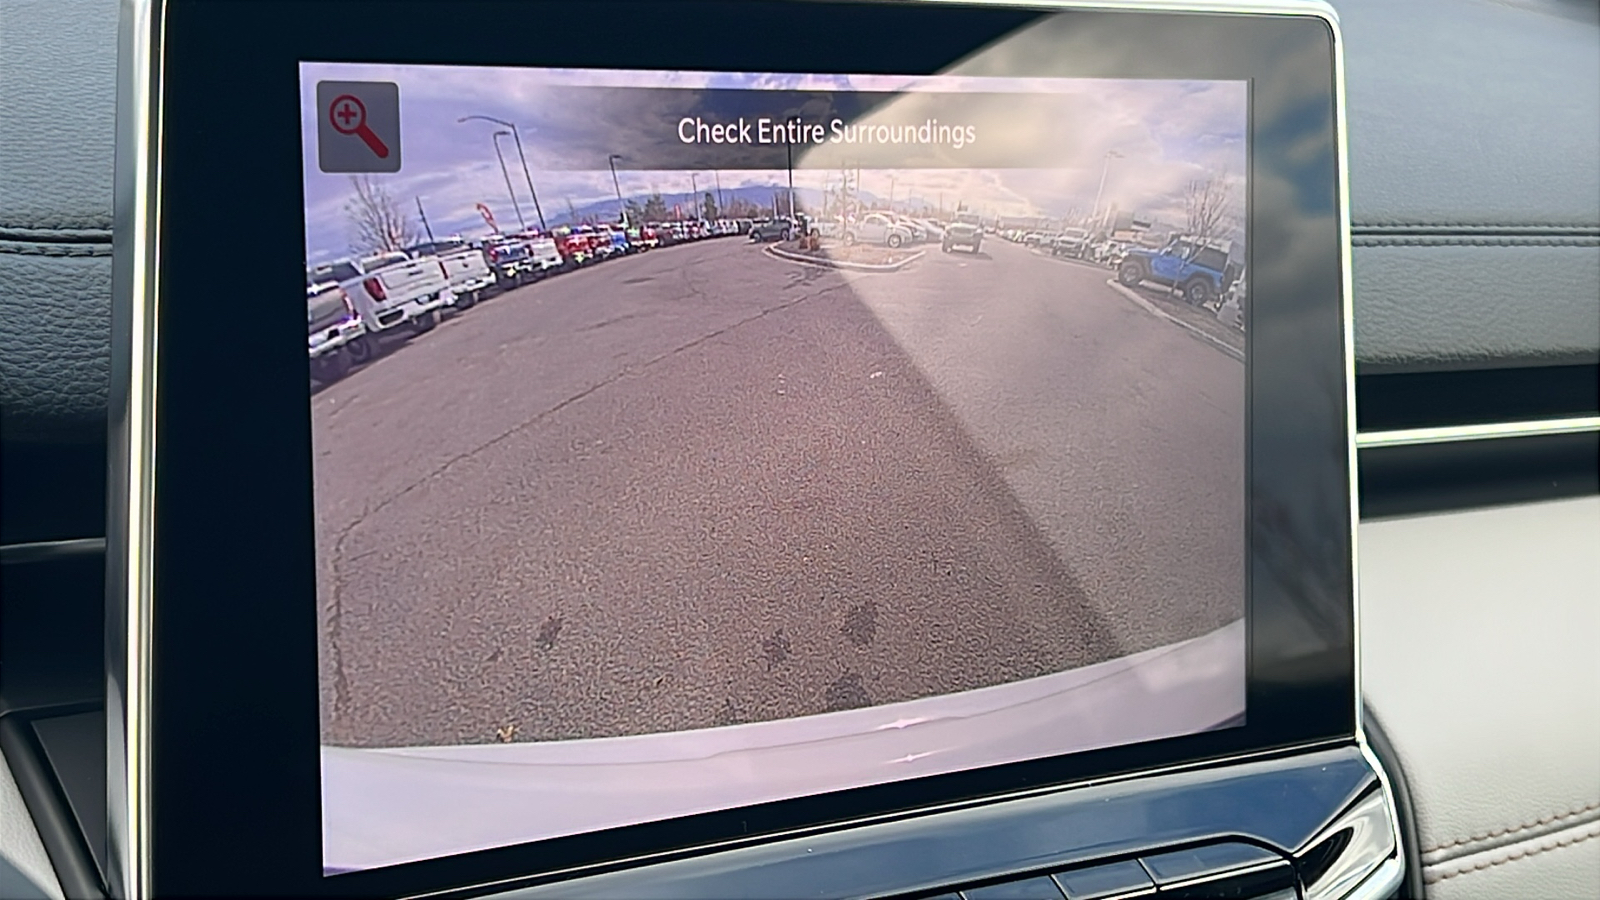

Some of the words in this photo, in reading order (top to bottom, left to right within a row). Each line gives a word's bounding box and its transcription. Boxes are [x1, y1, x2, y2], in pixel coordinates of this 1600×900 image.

[677, 117, 752, 144] Check
[758, 117, 825, 144] Entire
[829, 118, 977, 149] Surroundings
